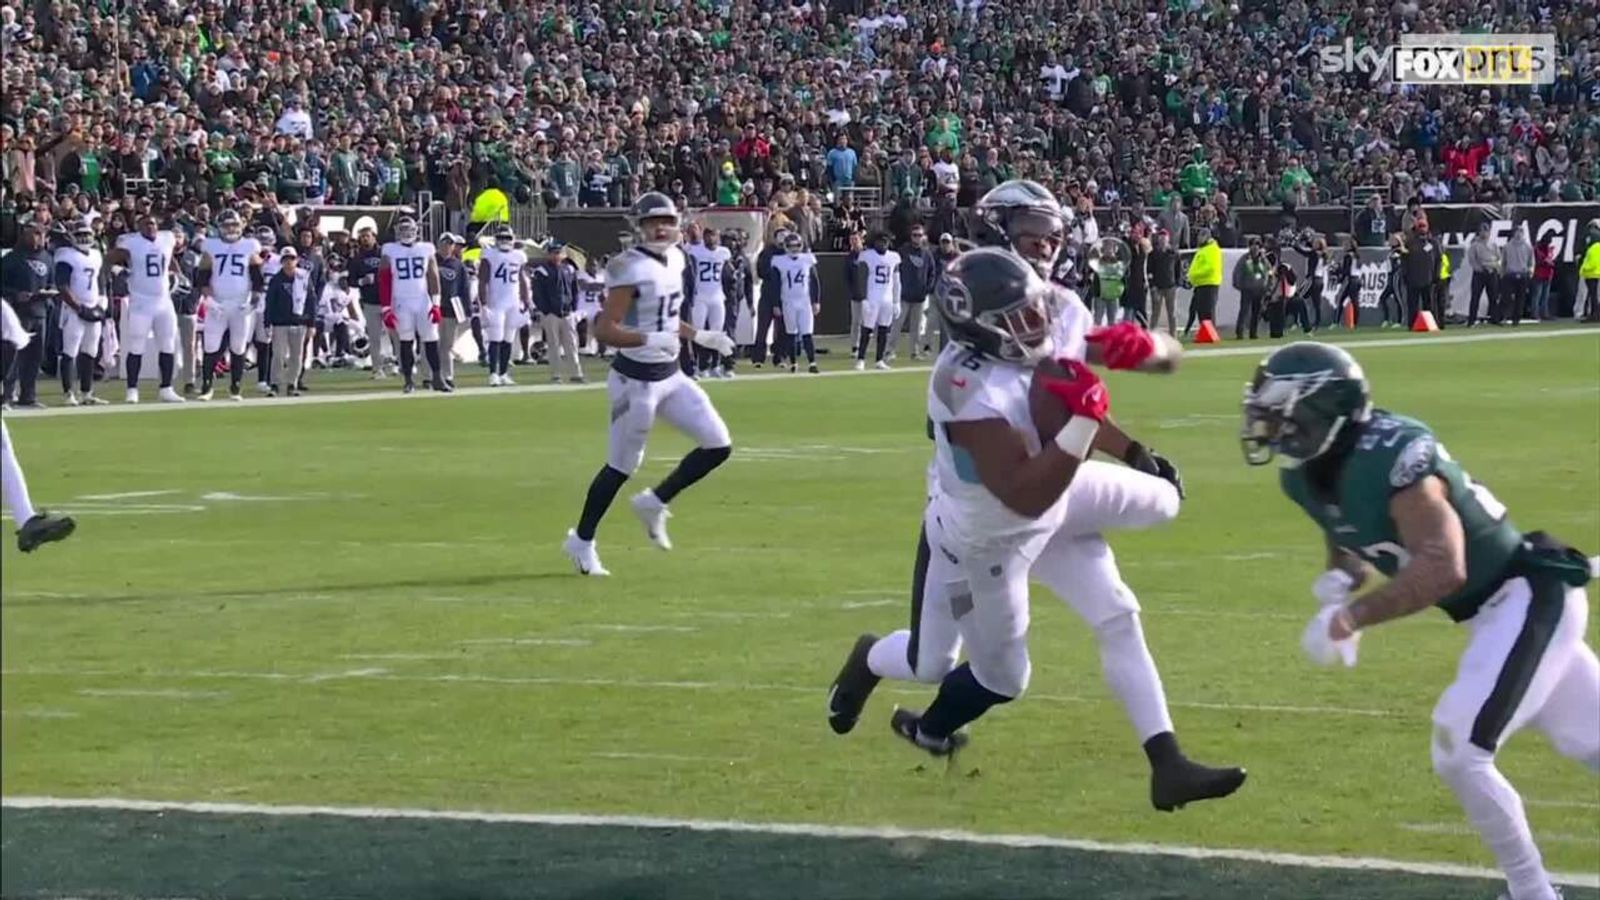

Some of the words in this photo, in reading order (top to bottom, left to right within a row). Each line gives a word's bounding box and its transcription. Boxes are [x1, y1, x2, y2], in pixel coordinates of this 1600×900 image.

[146, 254, 165, 277] 61
[214, 253, 244, 277] 75
[395, 257, 424, 280] 98
[494, 262, 518, 284] 42
[84, 268, 95, 290] 7
[787, 269, 804, 289] 14
